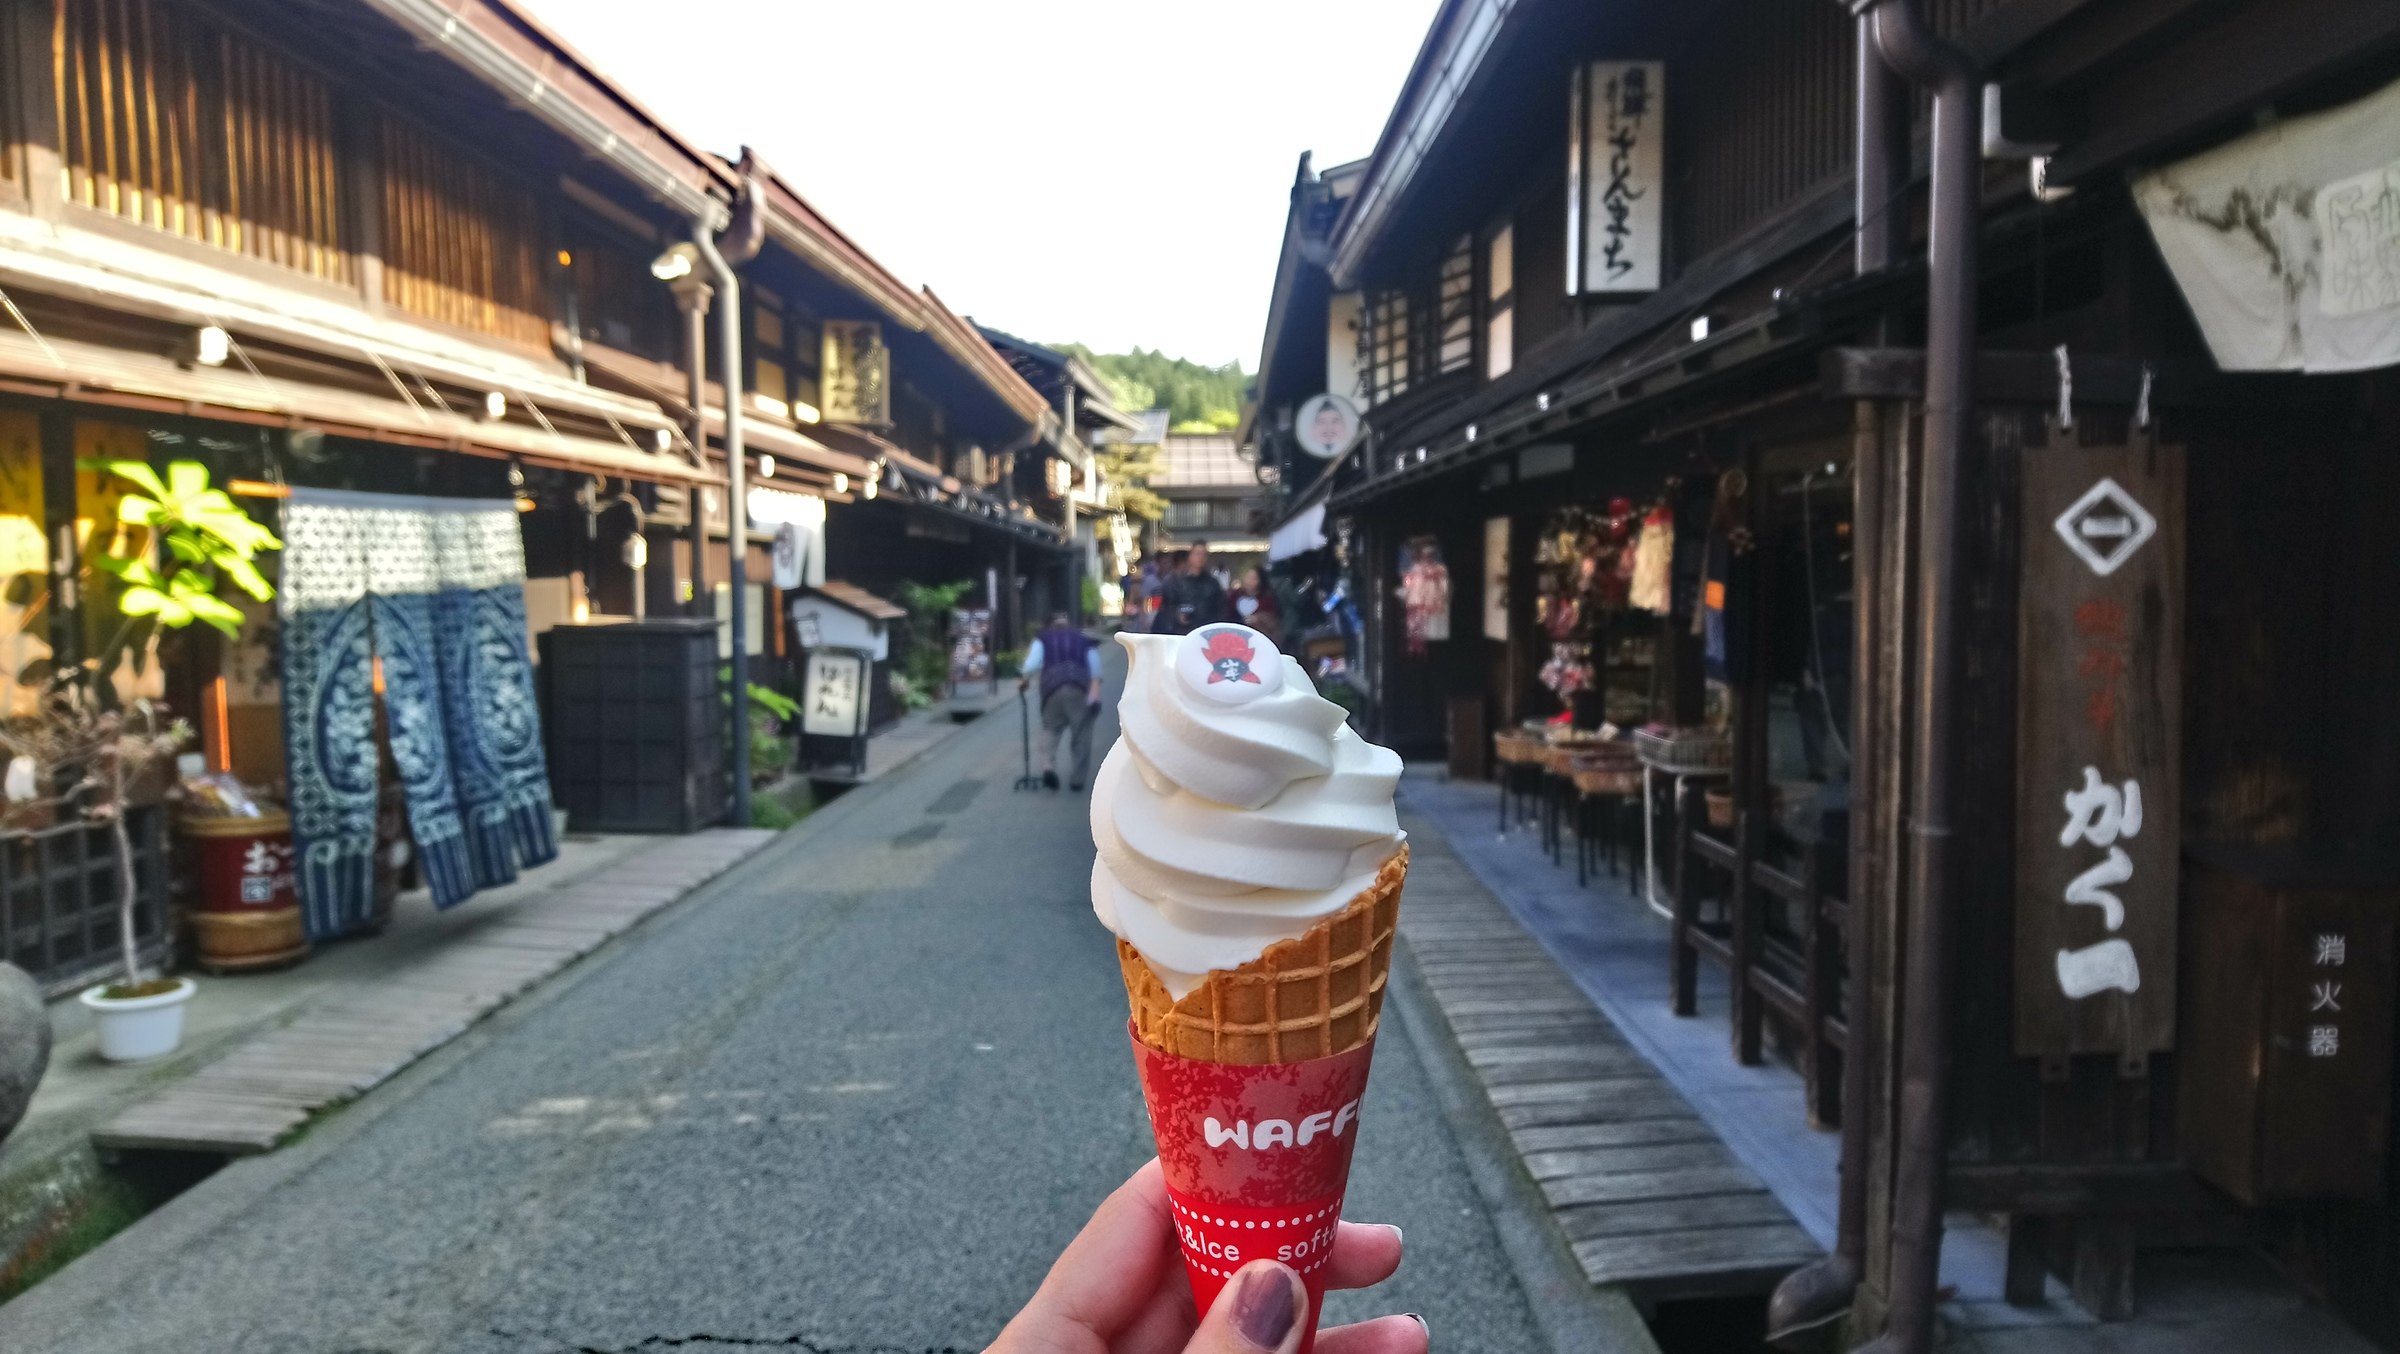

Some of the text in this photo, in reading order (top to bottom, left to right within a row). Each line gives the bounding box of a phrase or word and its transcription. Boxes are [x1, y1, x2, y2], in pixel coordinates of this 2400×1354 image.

[2058, 765, 2143, 999] かく一
[2311, 934, 2346, 1057] 消火器
[1204, 1092, 1364, 1150] WAFF
[1173, 1212, 1240, 1262] t&Ice
